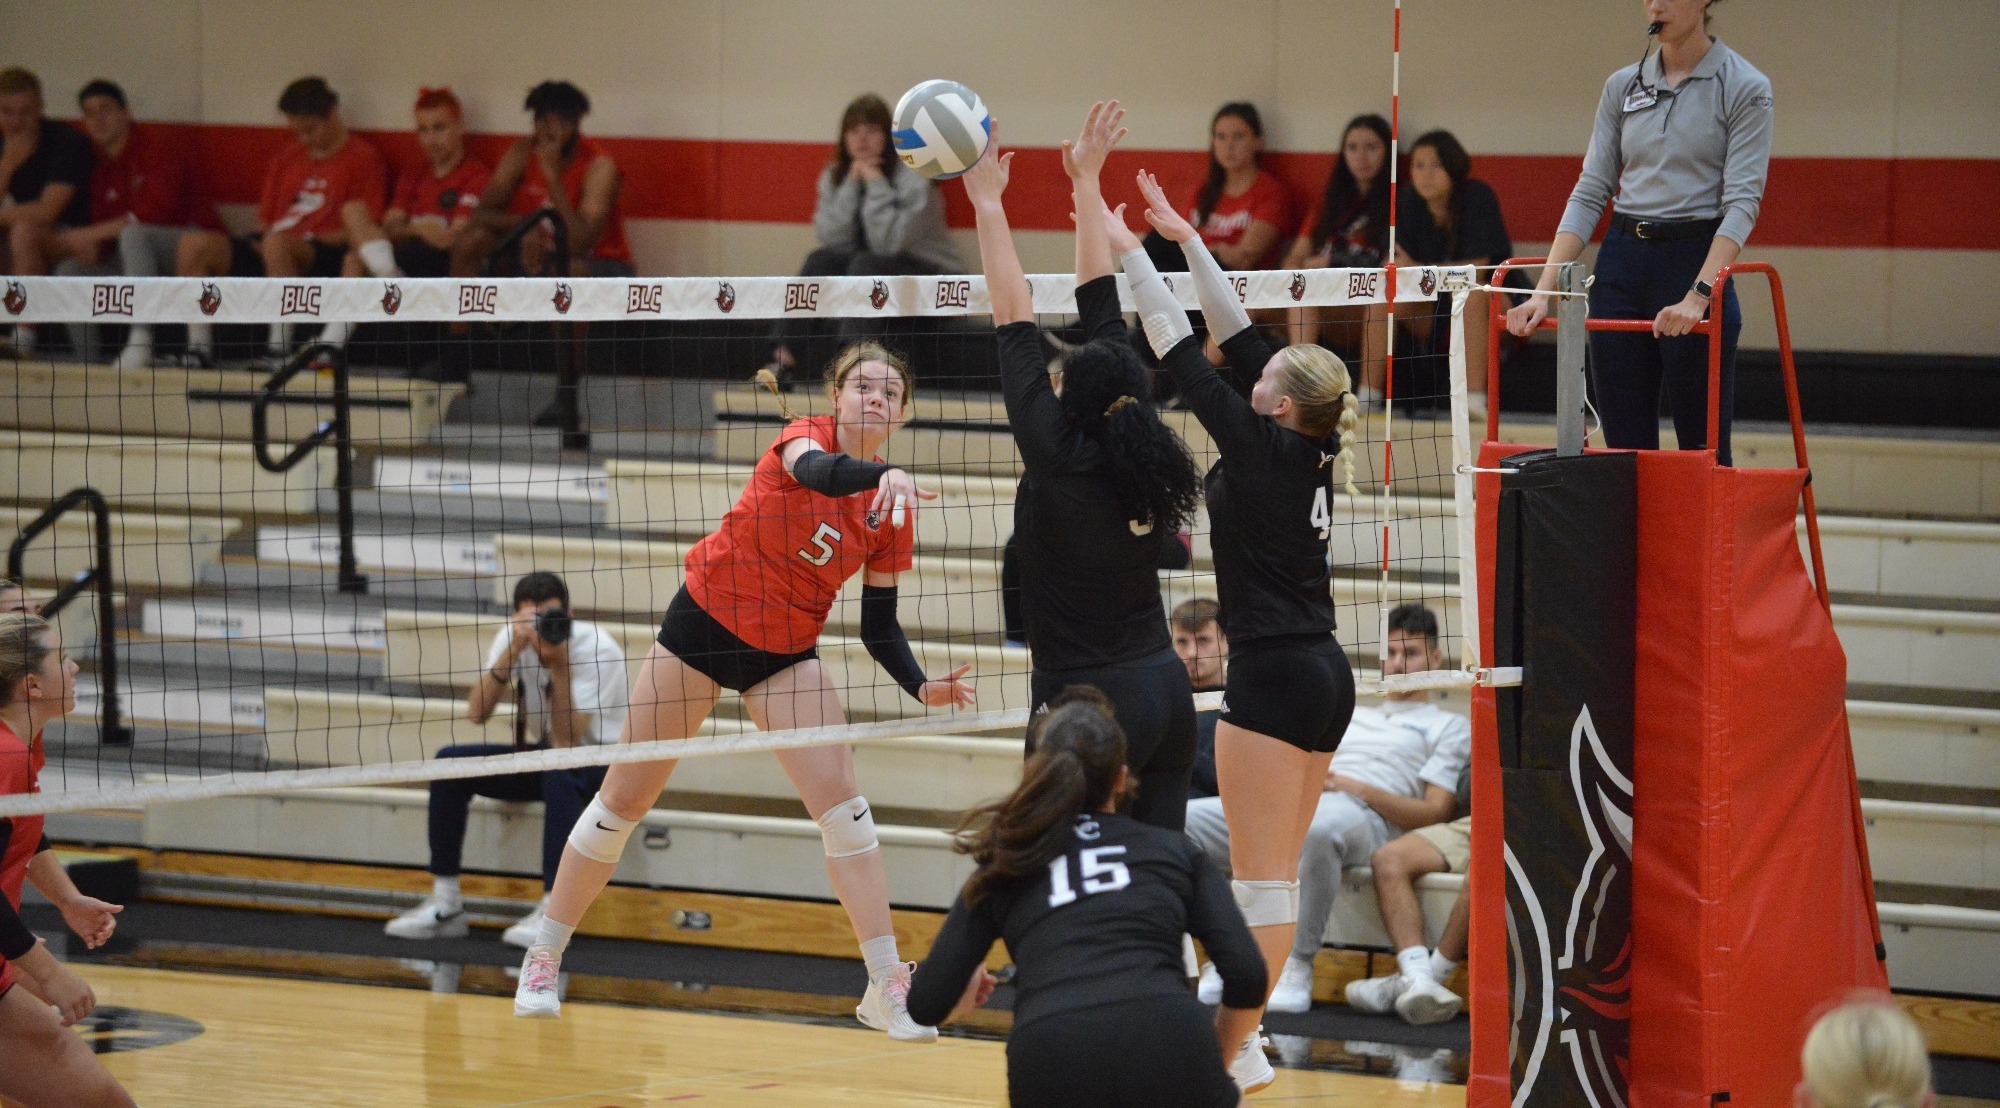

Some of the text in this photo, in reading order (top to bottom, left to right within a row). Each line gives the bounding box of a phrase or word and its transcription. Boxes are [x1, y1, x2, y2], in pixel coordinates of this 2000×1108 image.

[92, 284, 135, 316] BLC
[281, 285, 322, 316] BLC
[459, 284, 498, 315] BLC
[627, 284, 663, 314] BLC
[785, 284, 819, 312] BLC
[936, 281, 970, 309] BLC
[1348, 273, 1378, 299] BLC
[1310, 486, 1331, 539] 4
[798, 520, 843, 567] 5
[1048, 845, 1131, 908] 15
